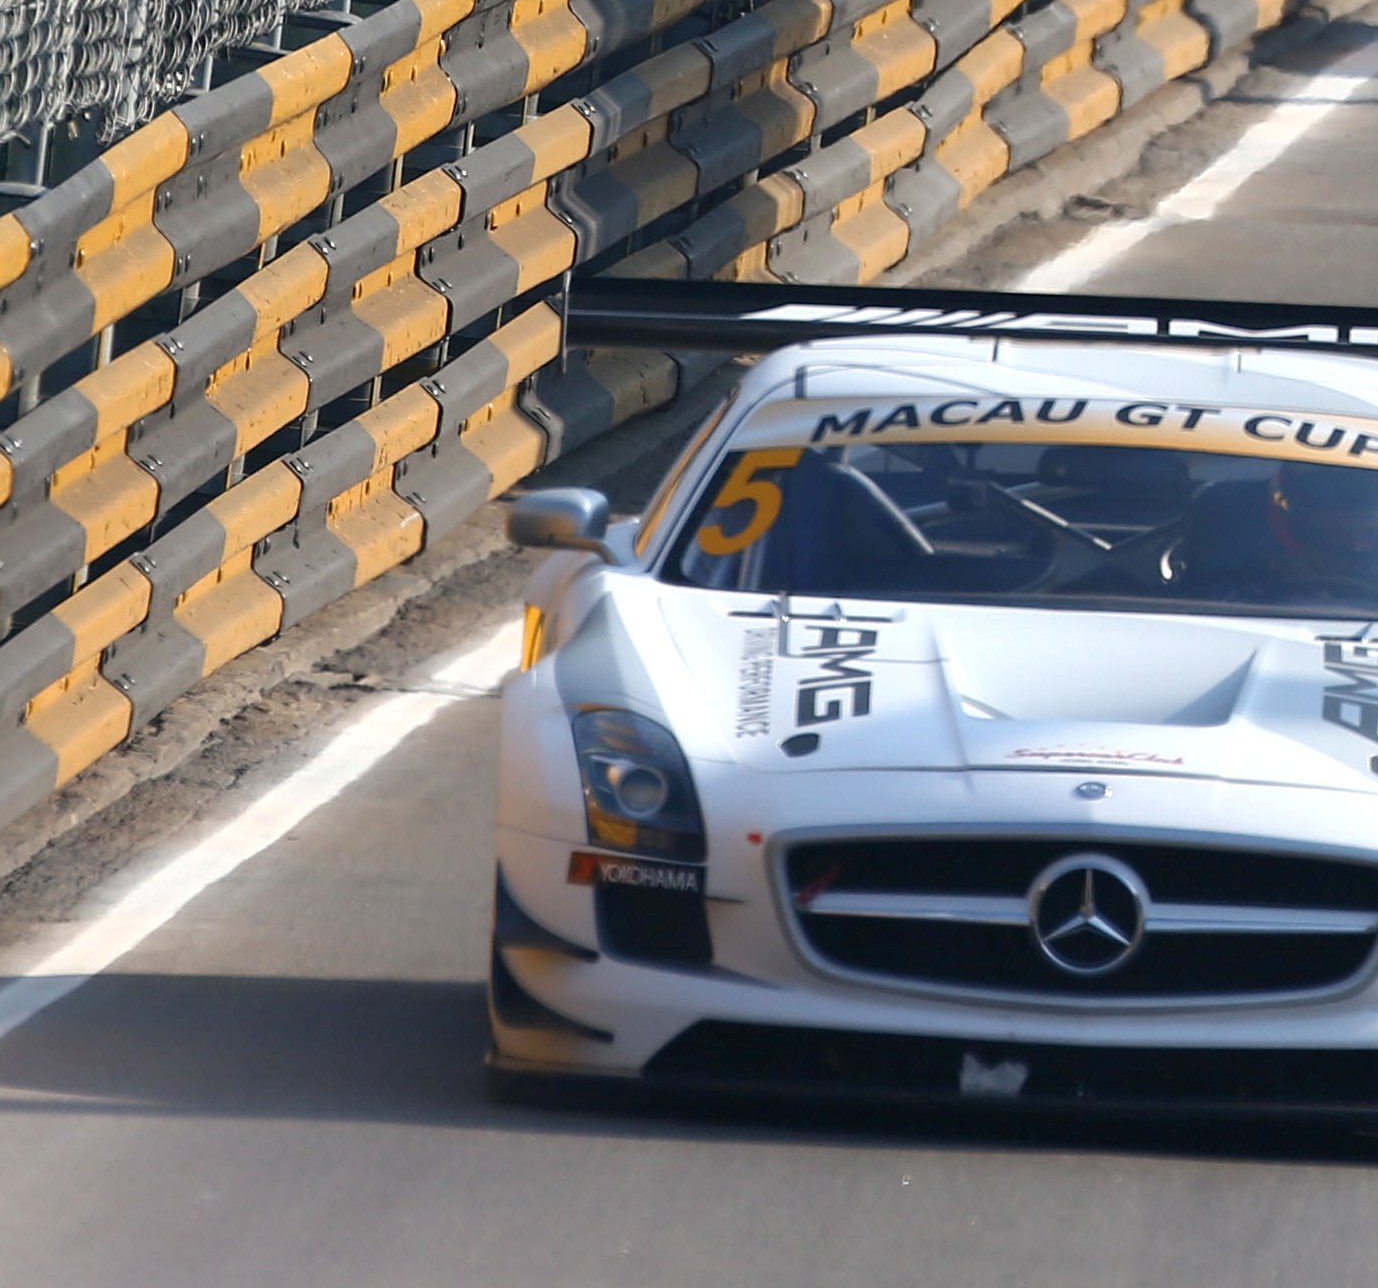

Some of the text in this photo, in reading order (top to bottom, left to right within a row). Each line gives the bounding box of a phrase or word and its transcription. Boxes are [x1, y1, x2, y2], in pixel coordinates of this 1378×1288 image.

[810, 399, 1089, 443] MACAU
[1115, 401, 1221, 430] GT
[697, 446, 805, 557] 5
[796, 625, 878, 728] AMG
[600, 863, 699, 892] YOKOHAMA
